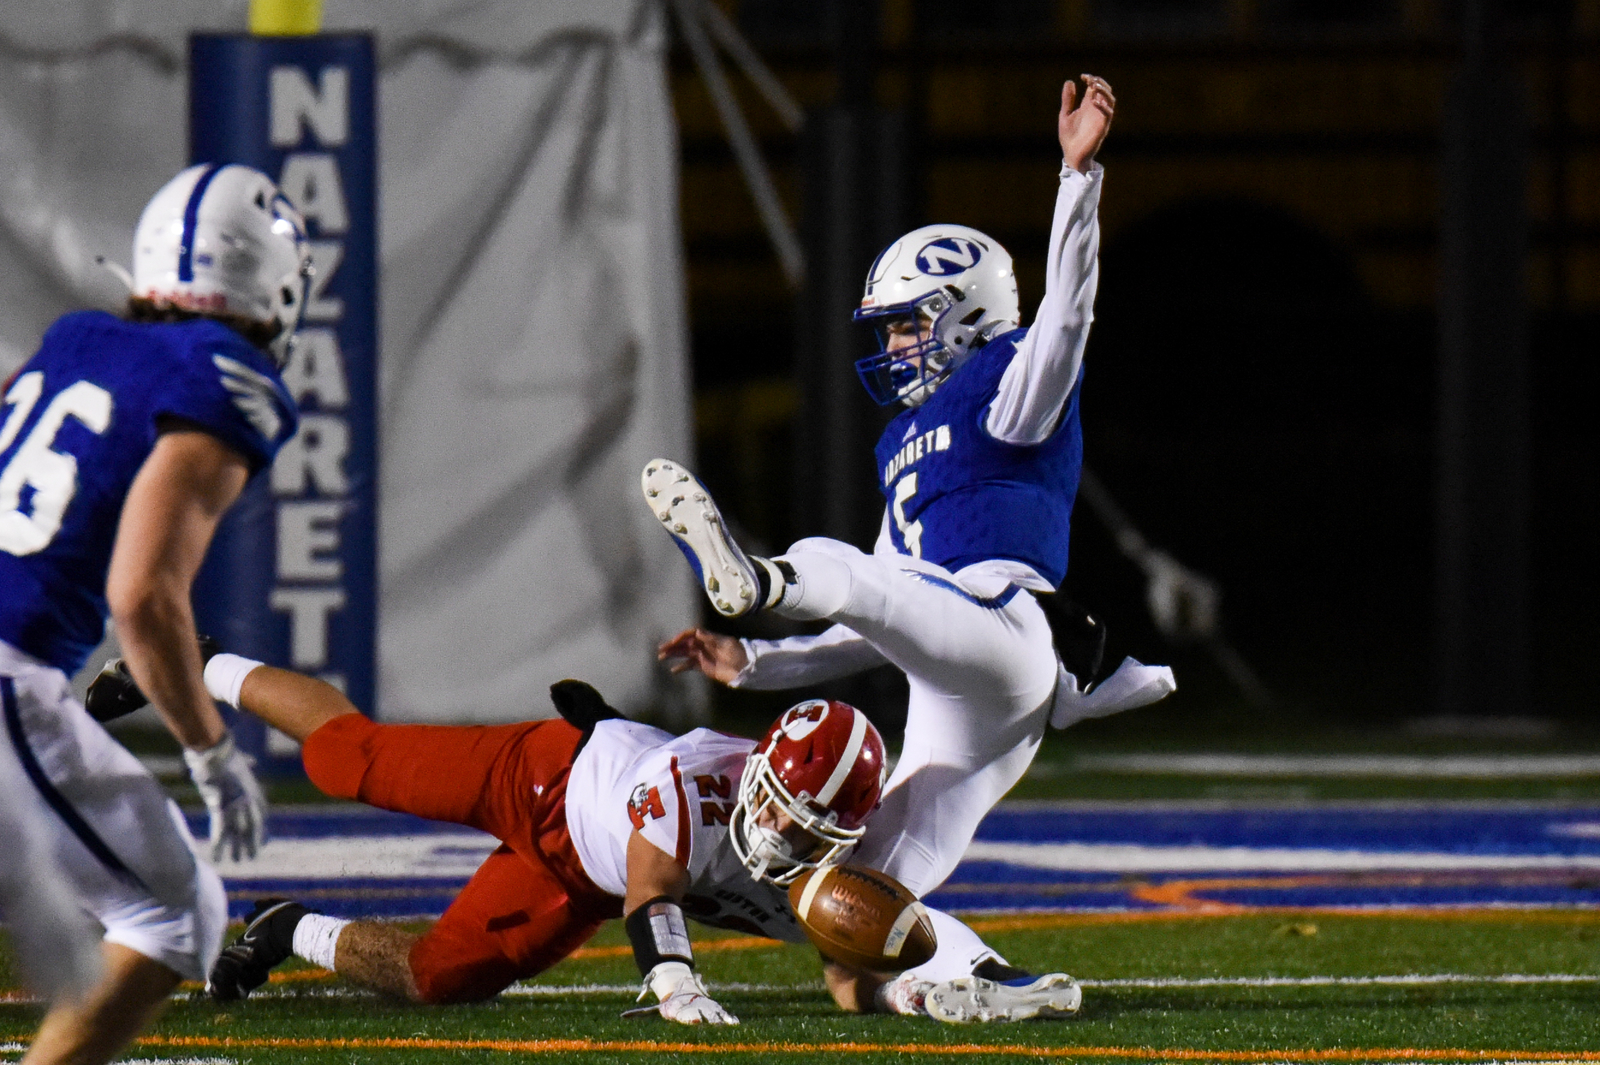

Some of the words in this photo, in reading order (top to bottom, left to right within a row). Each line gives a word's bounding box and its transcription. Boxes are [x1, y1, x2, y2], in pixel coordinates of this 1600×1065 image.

[926, 238, 977, 274] N
[265, 67, 351, 756] NAZARET
[893, 471, 923, 559] 5
